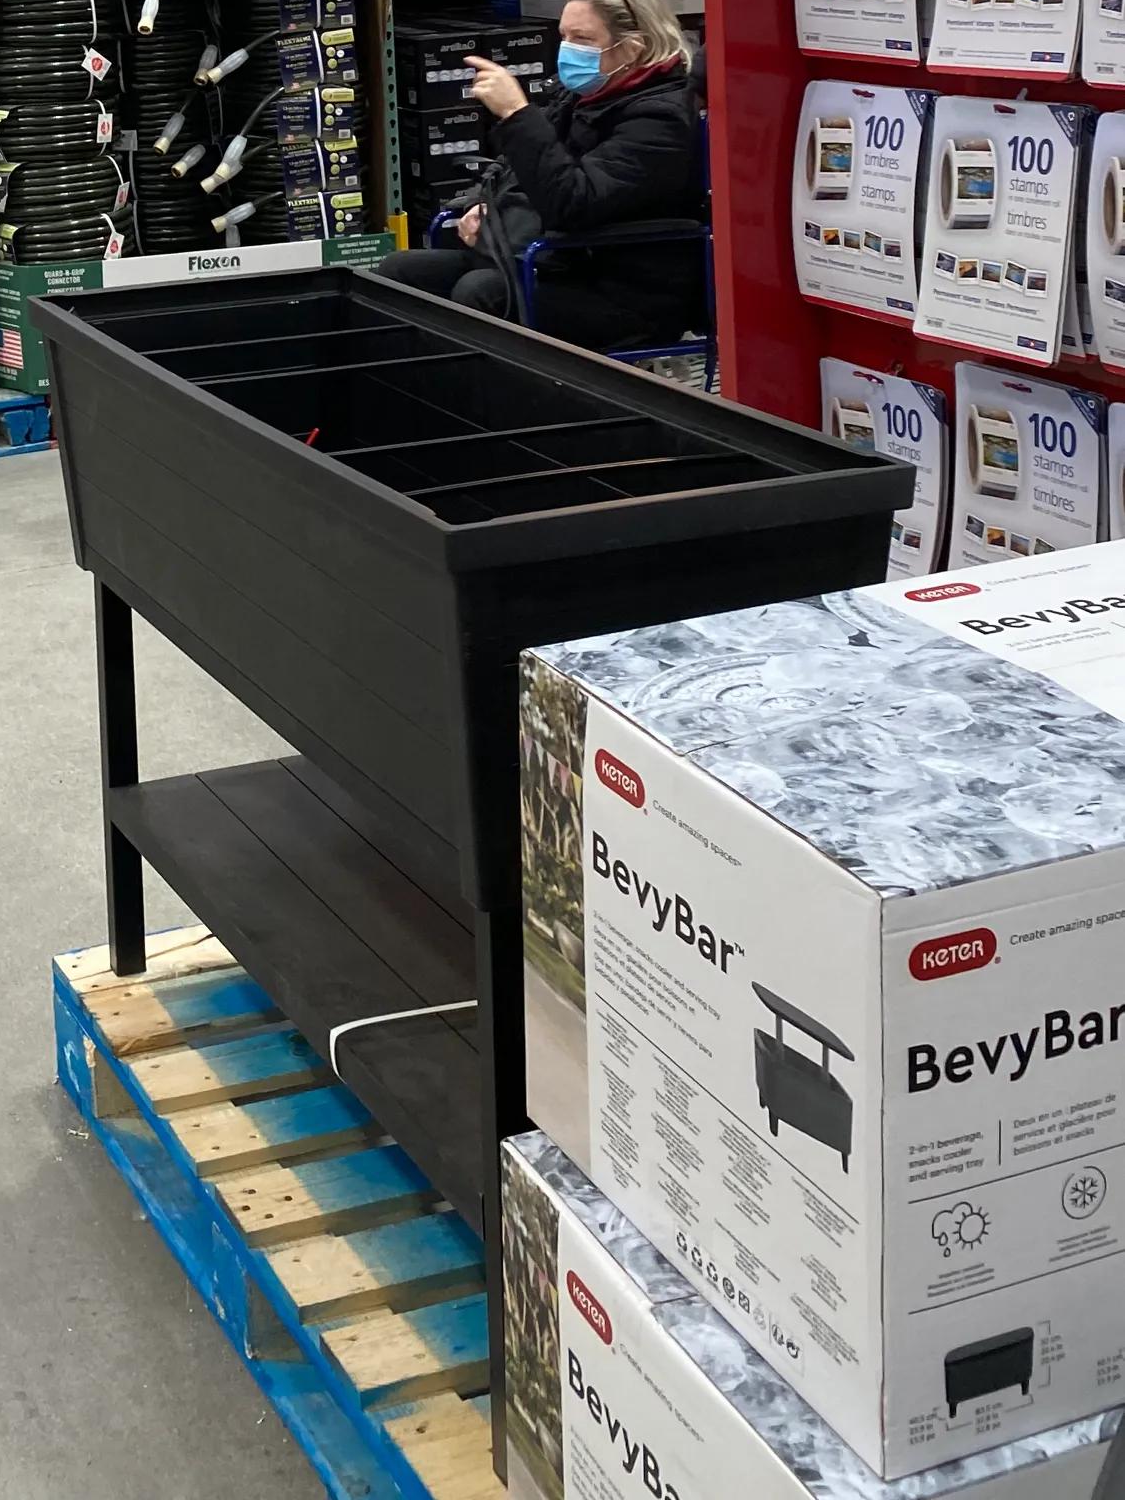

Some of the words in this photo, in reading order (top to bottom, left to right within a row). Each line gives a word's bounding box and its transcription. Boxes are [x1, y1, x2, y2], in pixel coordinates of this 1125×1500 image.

[864, 114, 905, 152] 100
[864, 153, 899, 170] timbres
[1007, 135, 1054, 175] 100
[861, 185, 895, 203] stamps
[1009, 177, 1049, 197] stamps
[1007, 210, 1047, 230] timbres
[188, 256, 241, 271] Flexon
[47, 276, 81, 285] CONNECTOR
[882, 402, 922, 443] 100
[1029, 412, 1076, 458] 100
[887, 441, 922, 461] stamps
[1033, 454, 1075, 479] stamps
[1033, 487, 1075, 513] timbres
[653, 800, 677, 825] Create
[678, 820, 709, 848] amazing
[1009, 929, 1046, 946] Create
[1049, 917, 1093, 937] amazing
